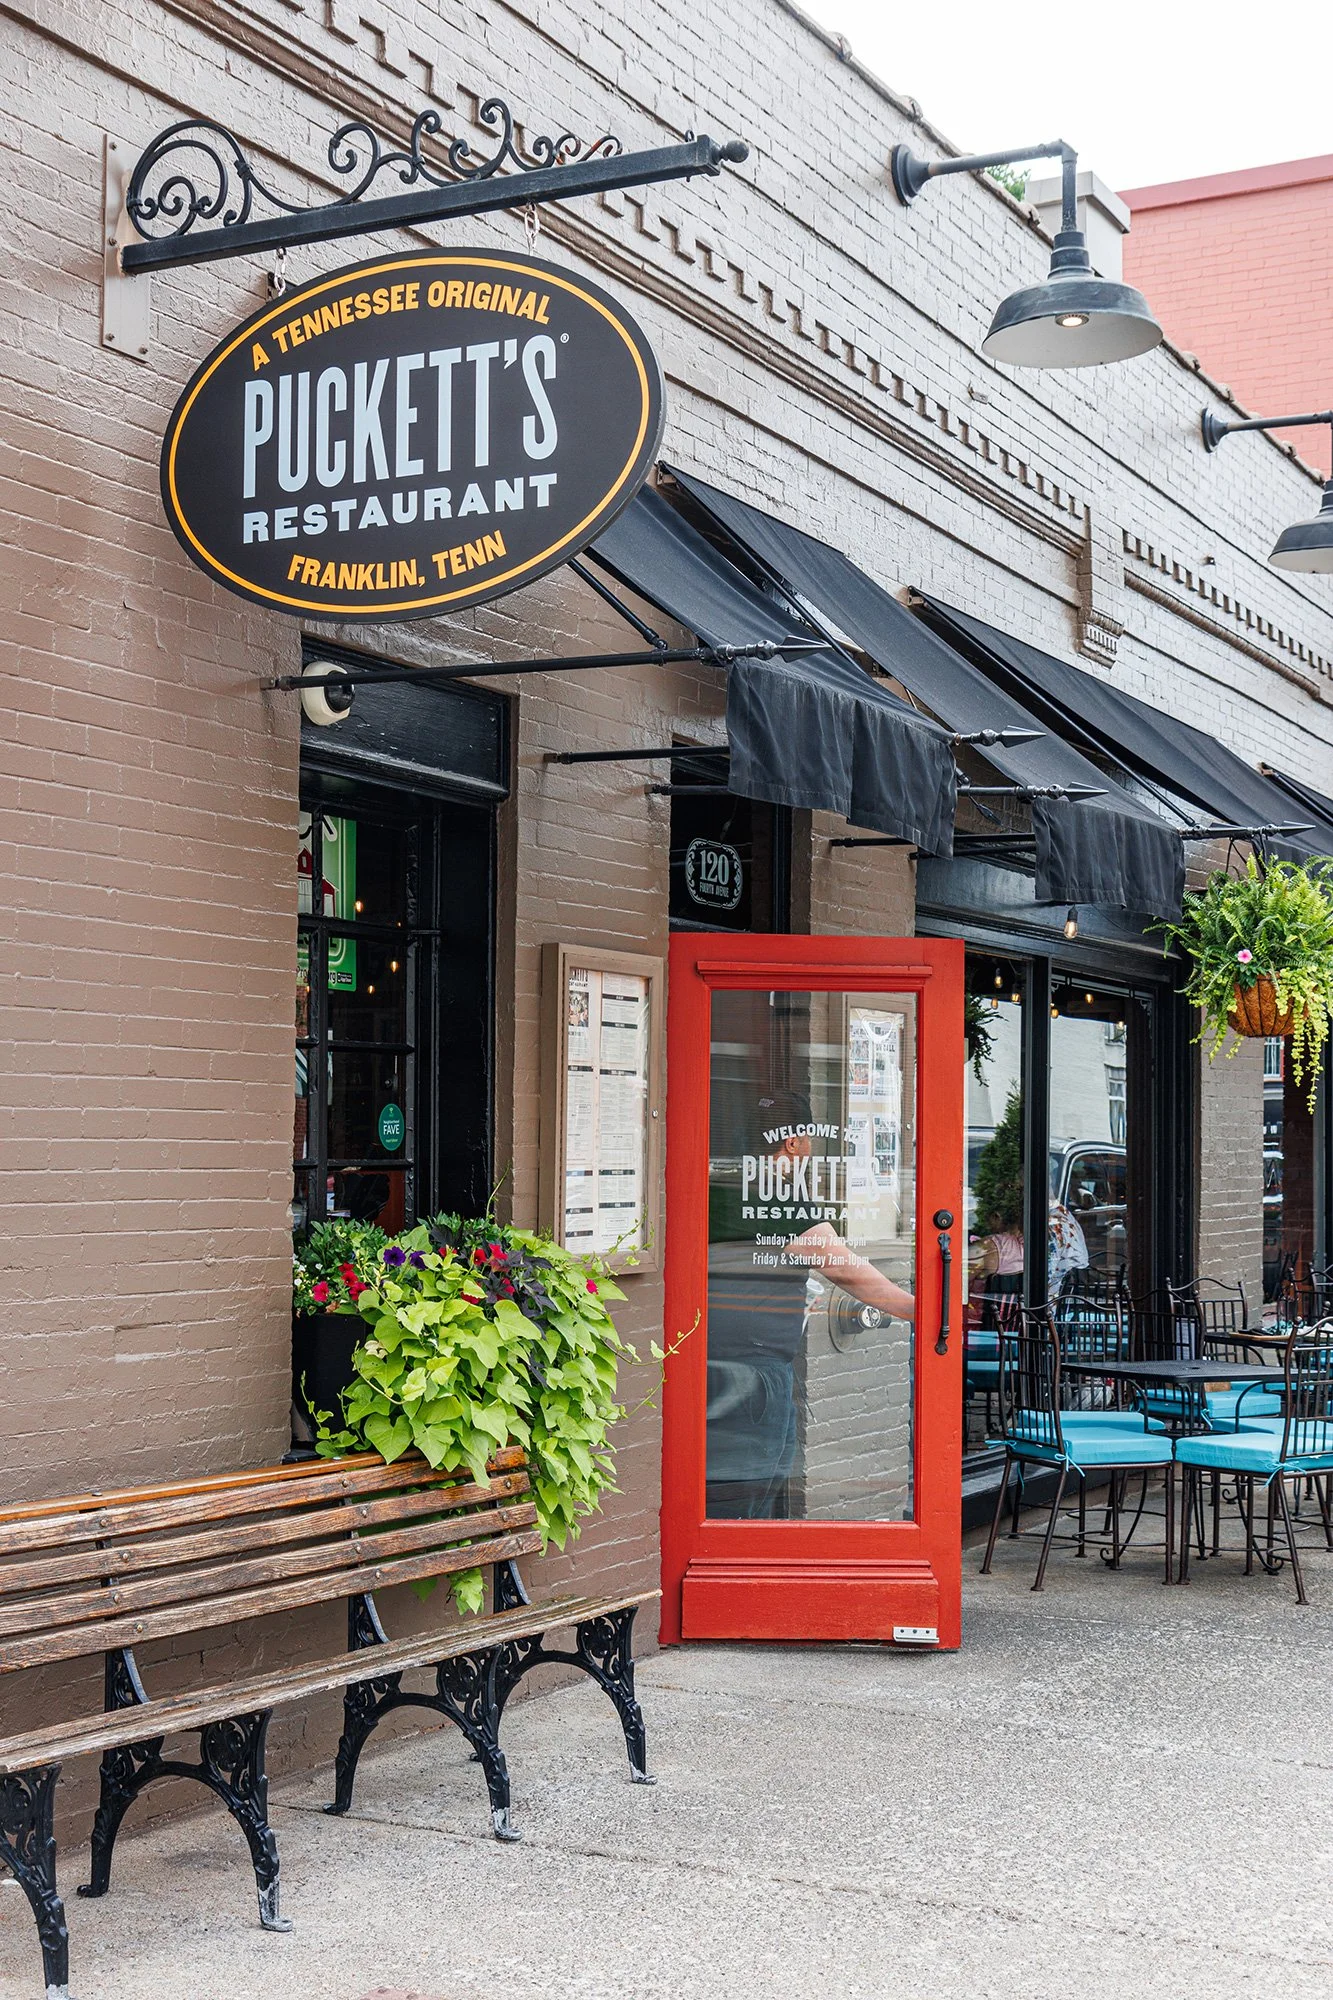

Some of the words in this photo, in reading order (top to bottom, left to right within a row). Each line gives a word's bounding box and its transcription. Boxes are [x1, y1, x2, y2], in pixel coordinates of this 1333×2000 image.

[252, 343, 270, 371] A
[272, 282, 420, 354] TENNESSEE
[427, 280, 551, 325] ORIGINAL
[243, 334, 558, 499] PUCKETT'S
[243, 473, 558, 544] RESTAURANT
[287, 554, 426, 590] FRANKLIN,
[432, 530, 507, 579] TENN
[699, 850, 729, 885] 120
[383, 1124, 400, 1135] FAVE
[763, 1123, 840, 1145] WELCOME
[742, 1155, 881, 1202] PUCKETTS
[742, 1207, 881, 1220] RESTAURANT
[756, 1233, 826, 1248] Sunday-Thursday
[753, 1252, 778, 1268] Friday
[780, 1253, 787, 1265] &
[789, 1252, 826, 1268] Saturday
